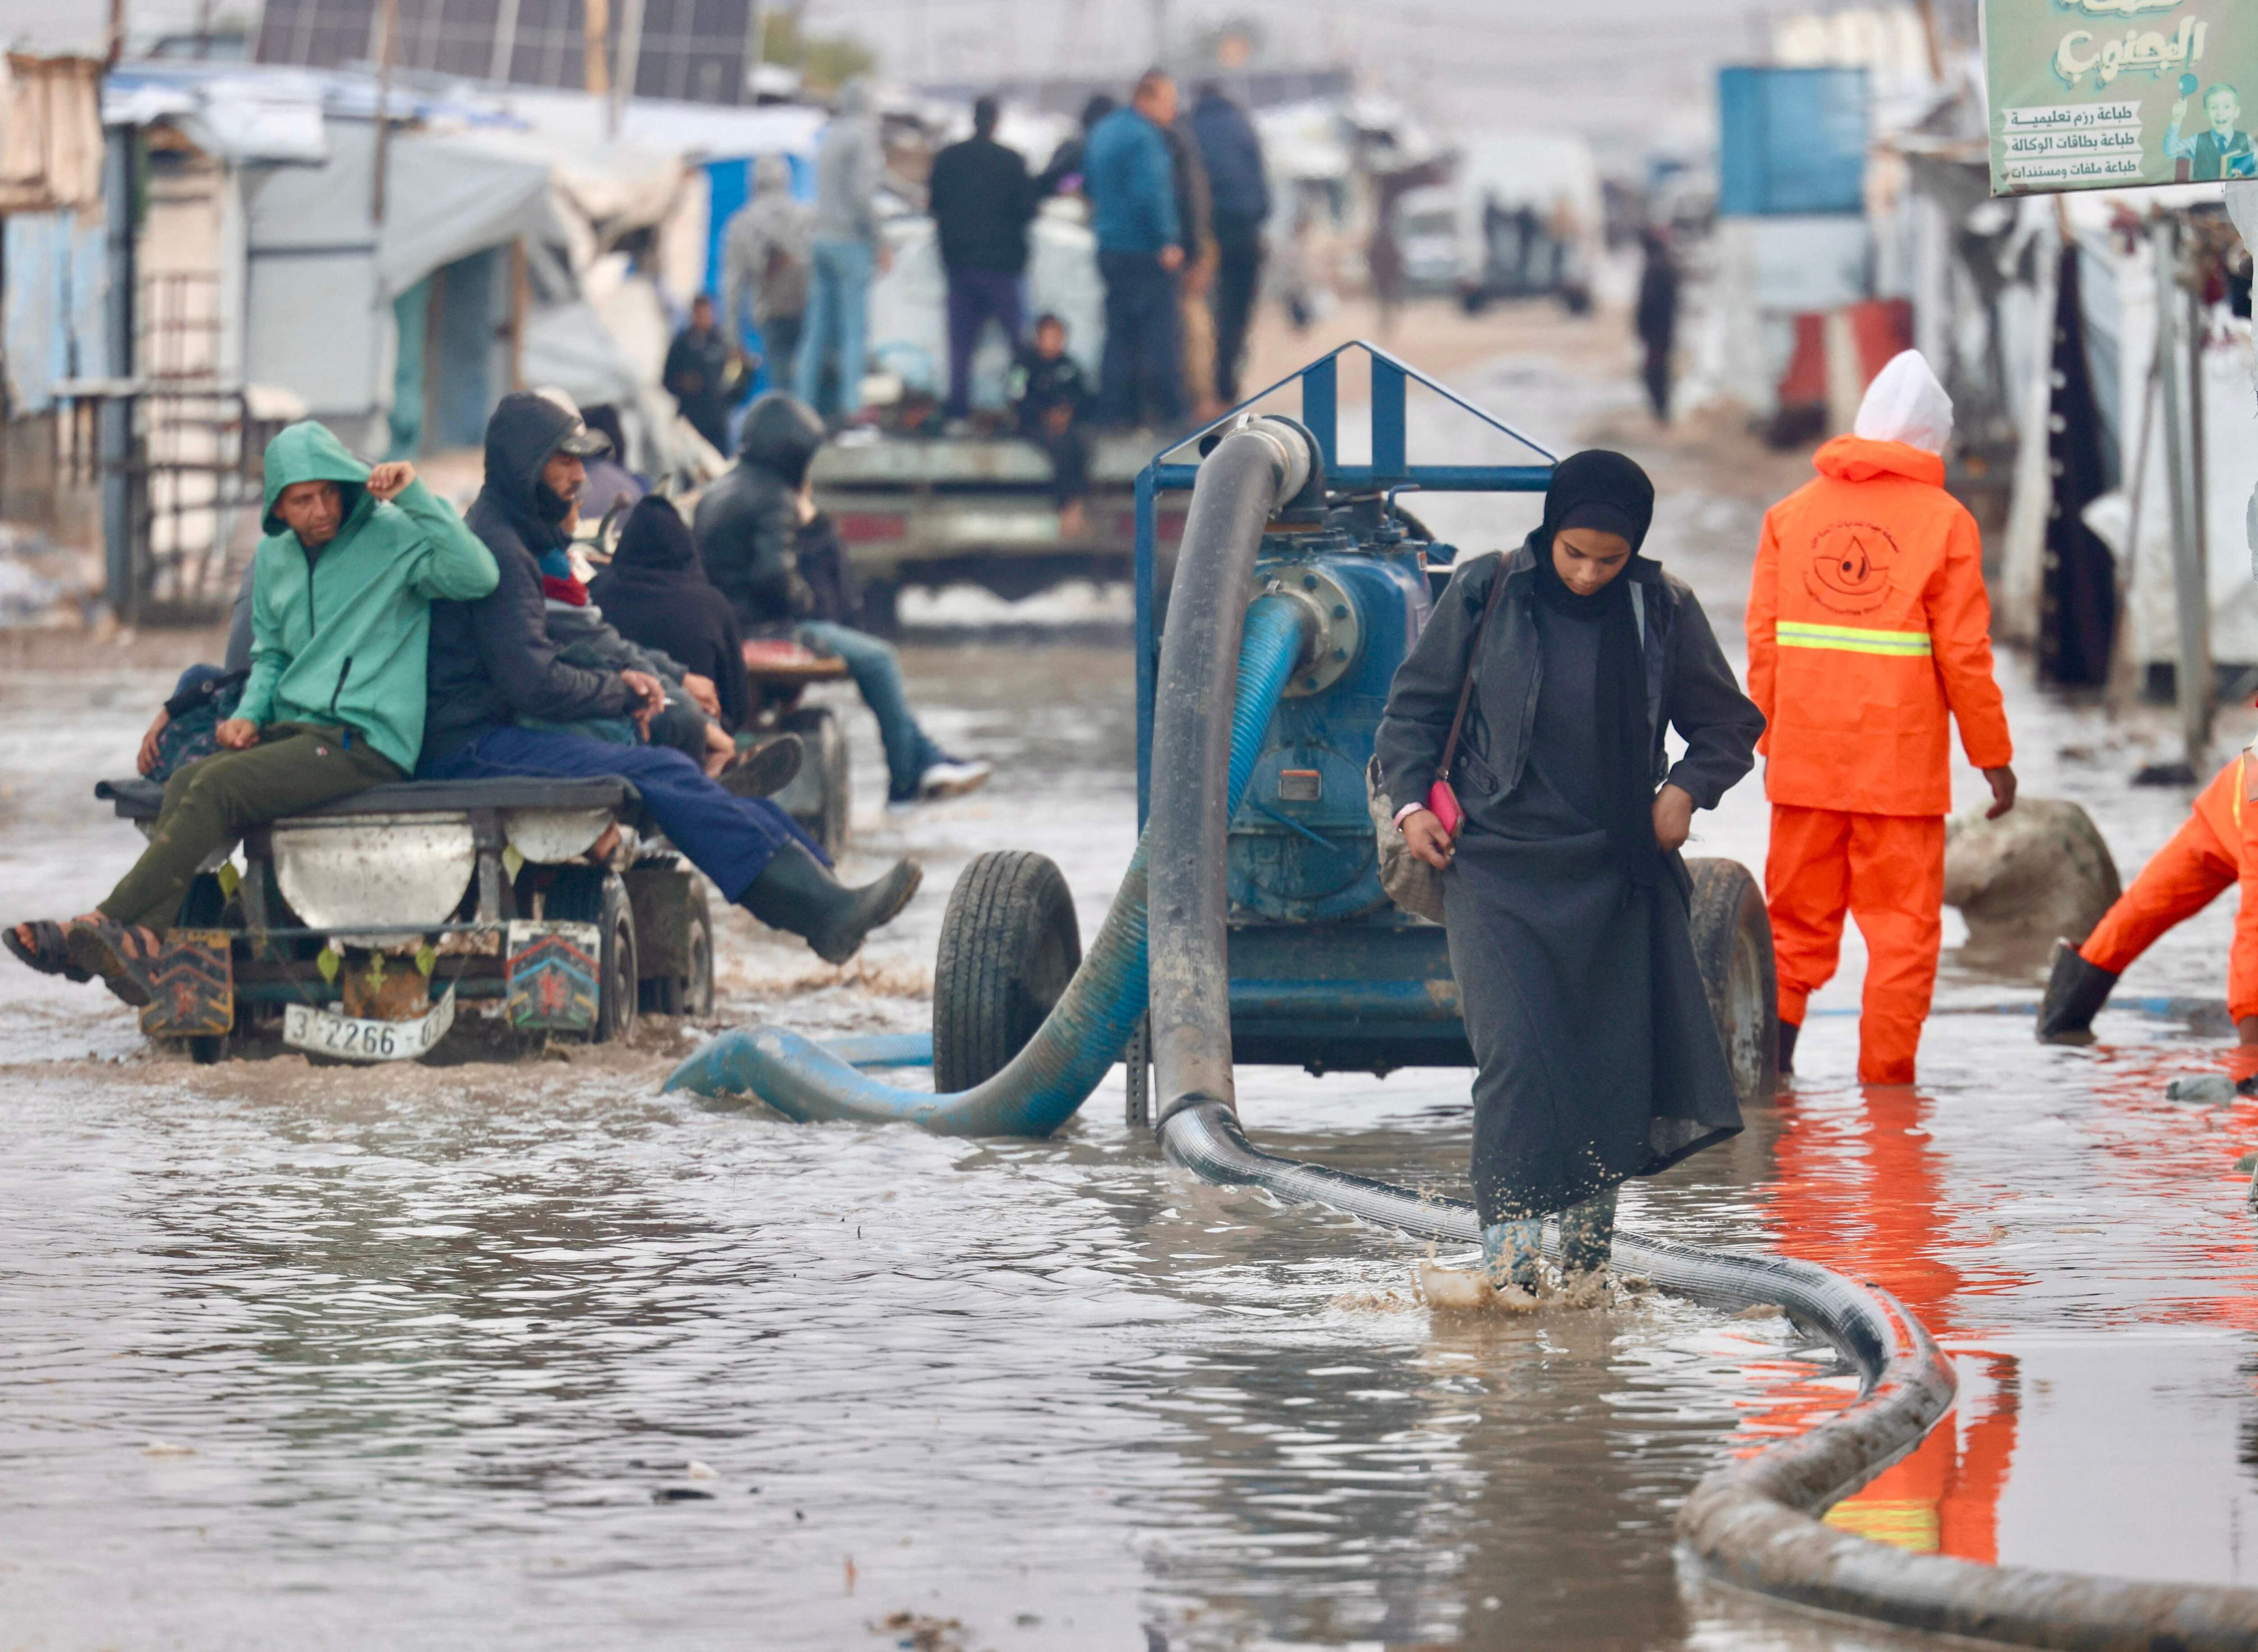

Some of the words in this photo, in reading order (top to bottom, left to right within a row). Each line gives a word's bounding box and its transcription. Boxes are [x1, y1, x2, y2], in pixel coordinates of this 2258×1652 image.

[2056, 15, 2209, 83] الجنوب
[2074, 112, 2094, 127] رزم
[2097, 106, 2132, 123] طباعة
[2012, 137, 2053, 154] الوكالة
[2057, 134, 2098, 151] بطاقات
[2101, 132, 2135, 149] طباعة
[2011, 166, 2067, 179] ومستندات
[2070, 163, 2102, 175] ملفات
[2105, 160, 2137, 175] طباعة
